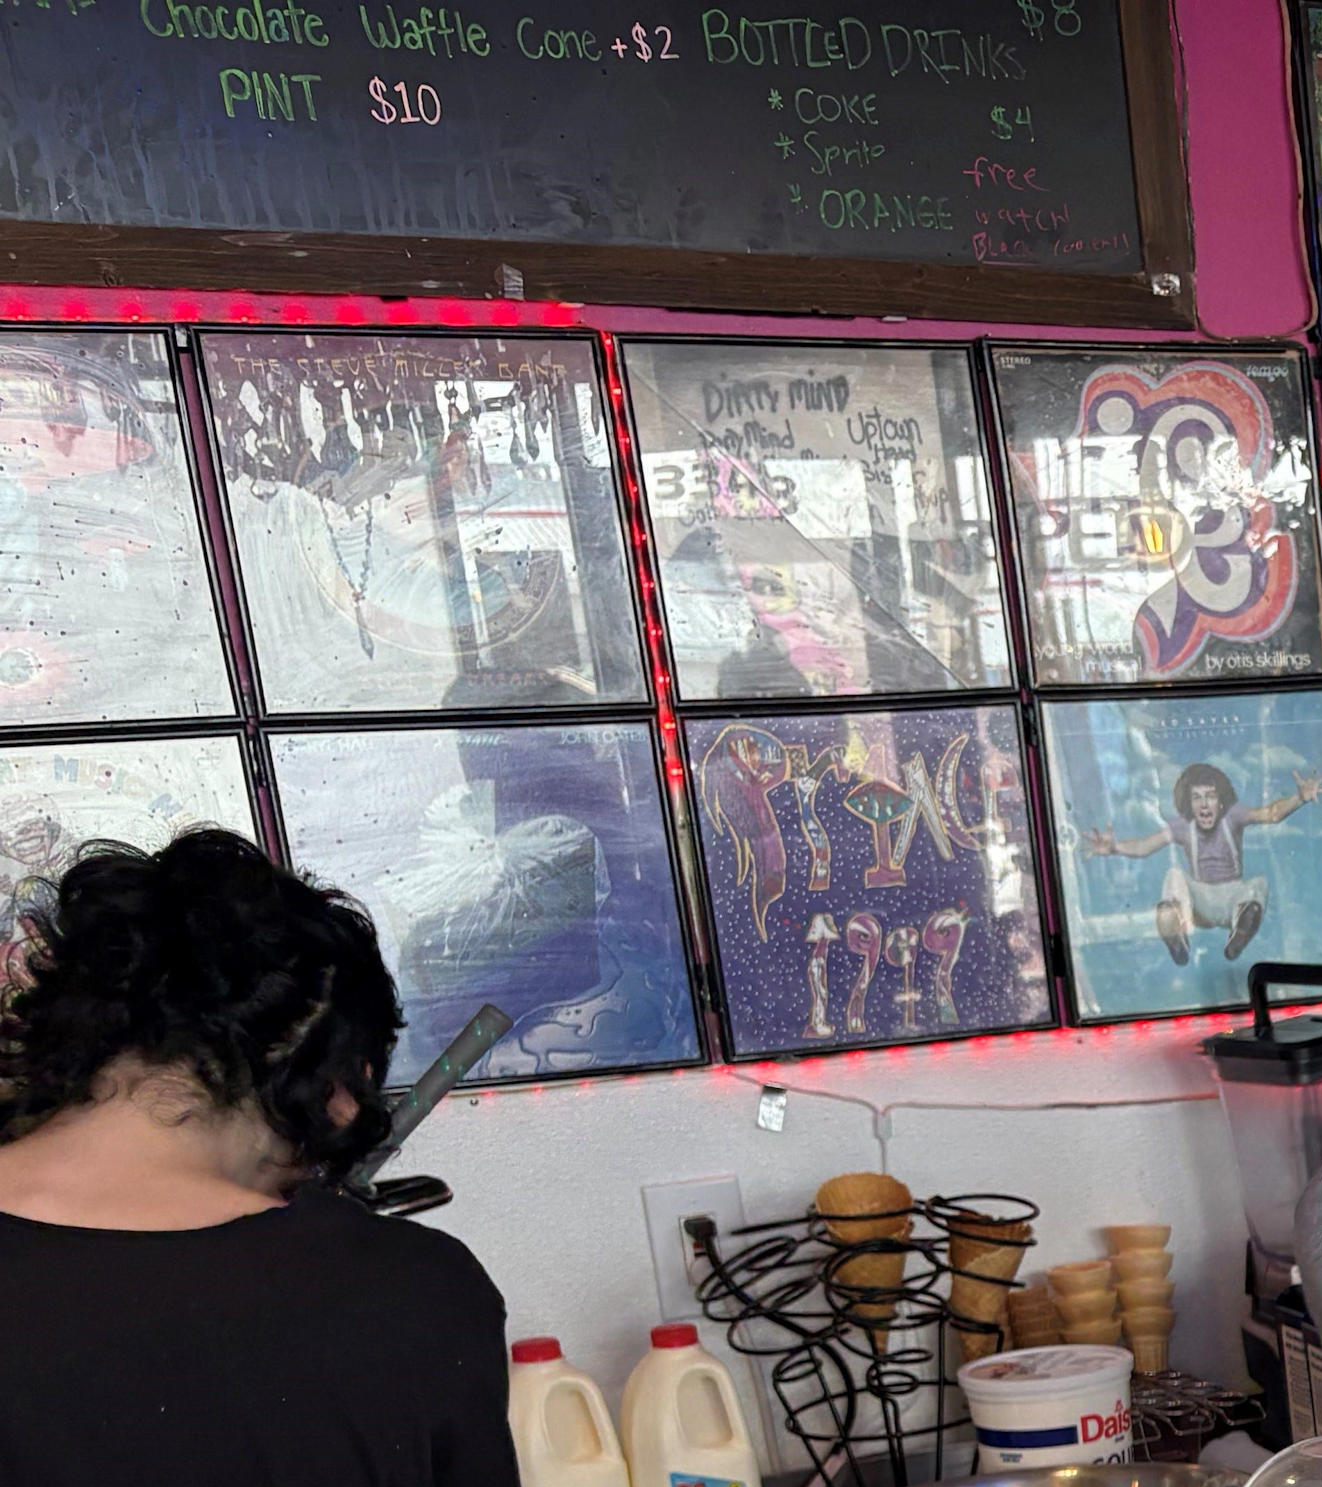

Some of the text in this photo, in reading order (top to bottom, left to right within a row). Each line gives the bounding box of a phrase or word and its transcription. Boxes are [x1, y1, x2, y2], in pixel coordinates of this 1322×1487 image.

[141, 0, 329, 46] Chocolate
[364, 3, 489, 58] Waffle
[516, 16, 602, 61] Cone
[702, 8, 872, 71] BOTTLED
[880, 24, 1027, 84] DRINKS
[218, 67, 441, 126] PINT $10
[794, 87, 1036, 142] COKE $4
[819, 188, 953, 232] ORANGE
[235, 357, 281, 374] THE
[1205, 650, 1312, 671] by otis skillings
